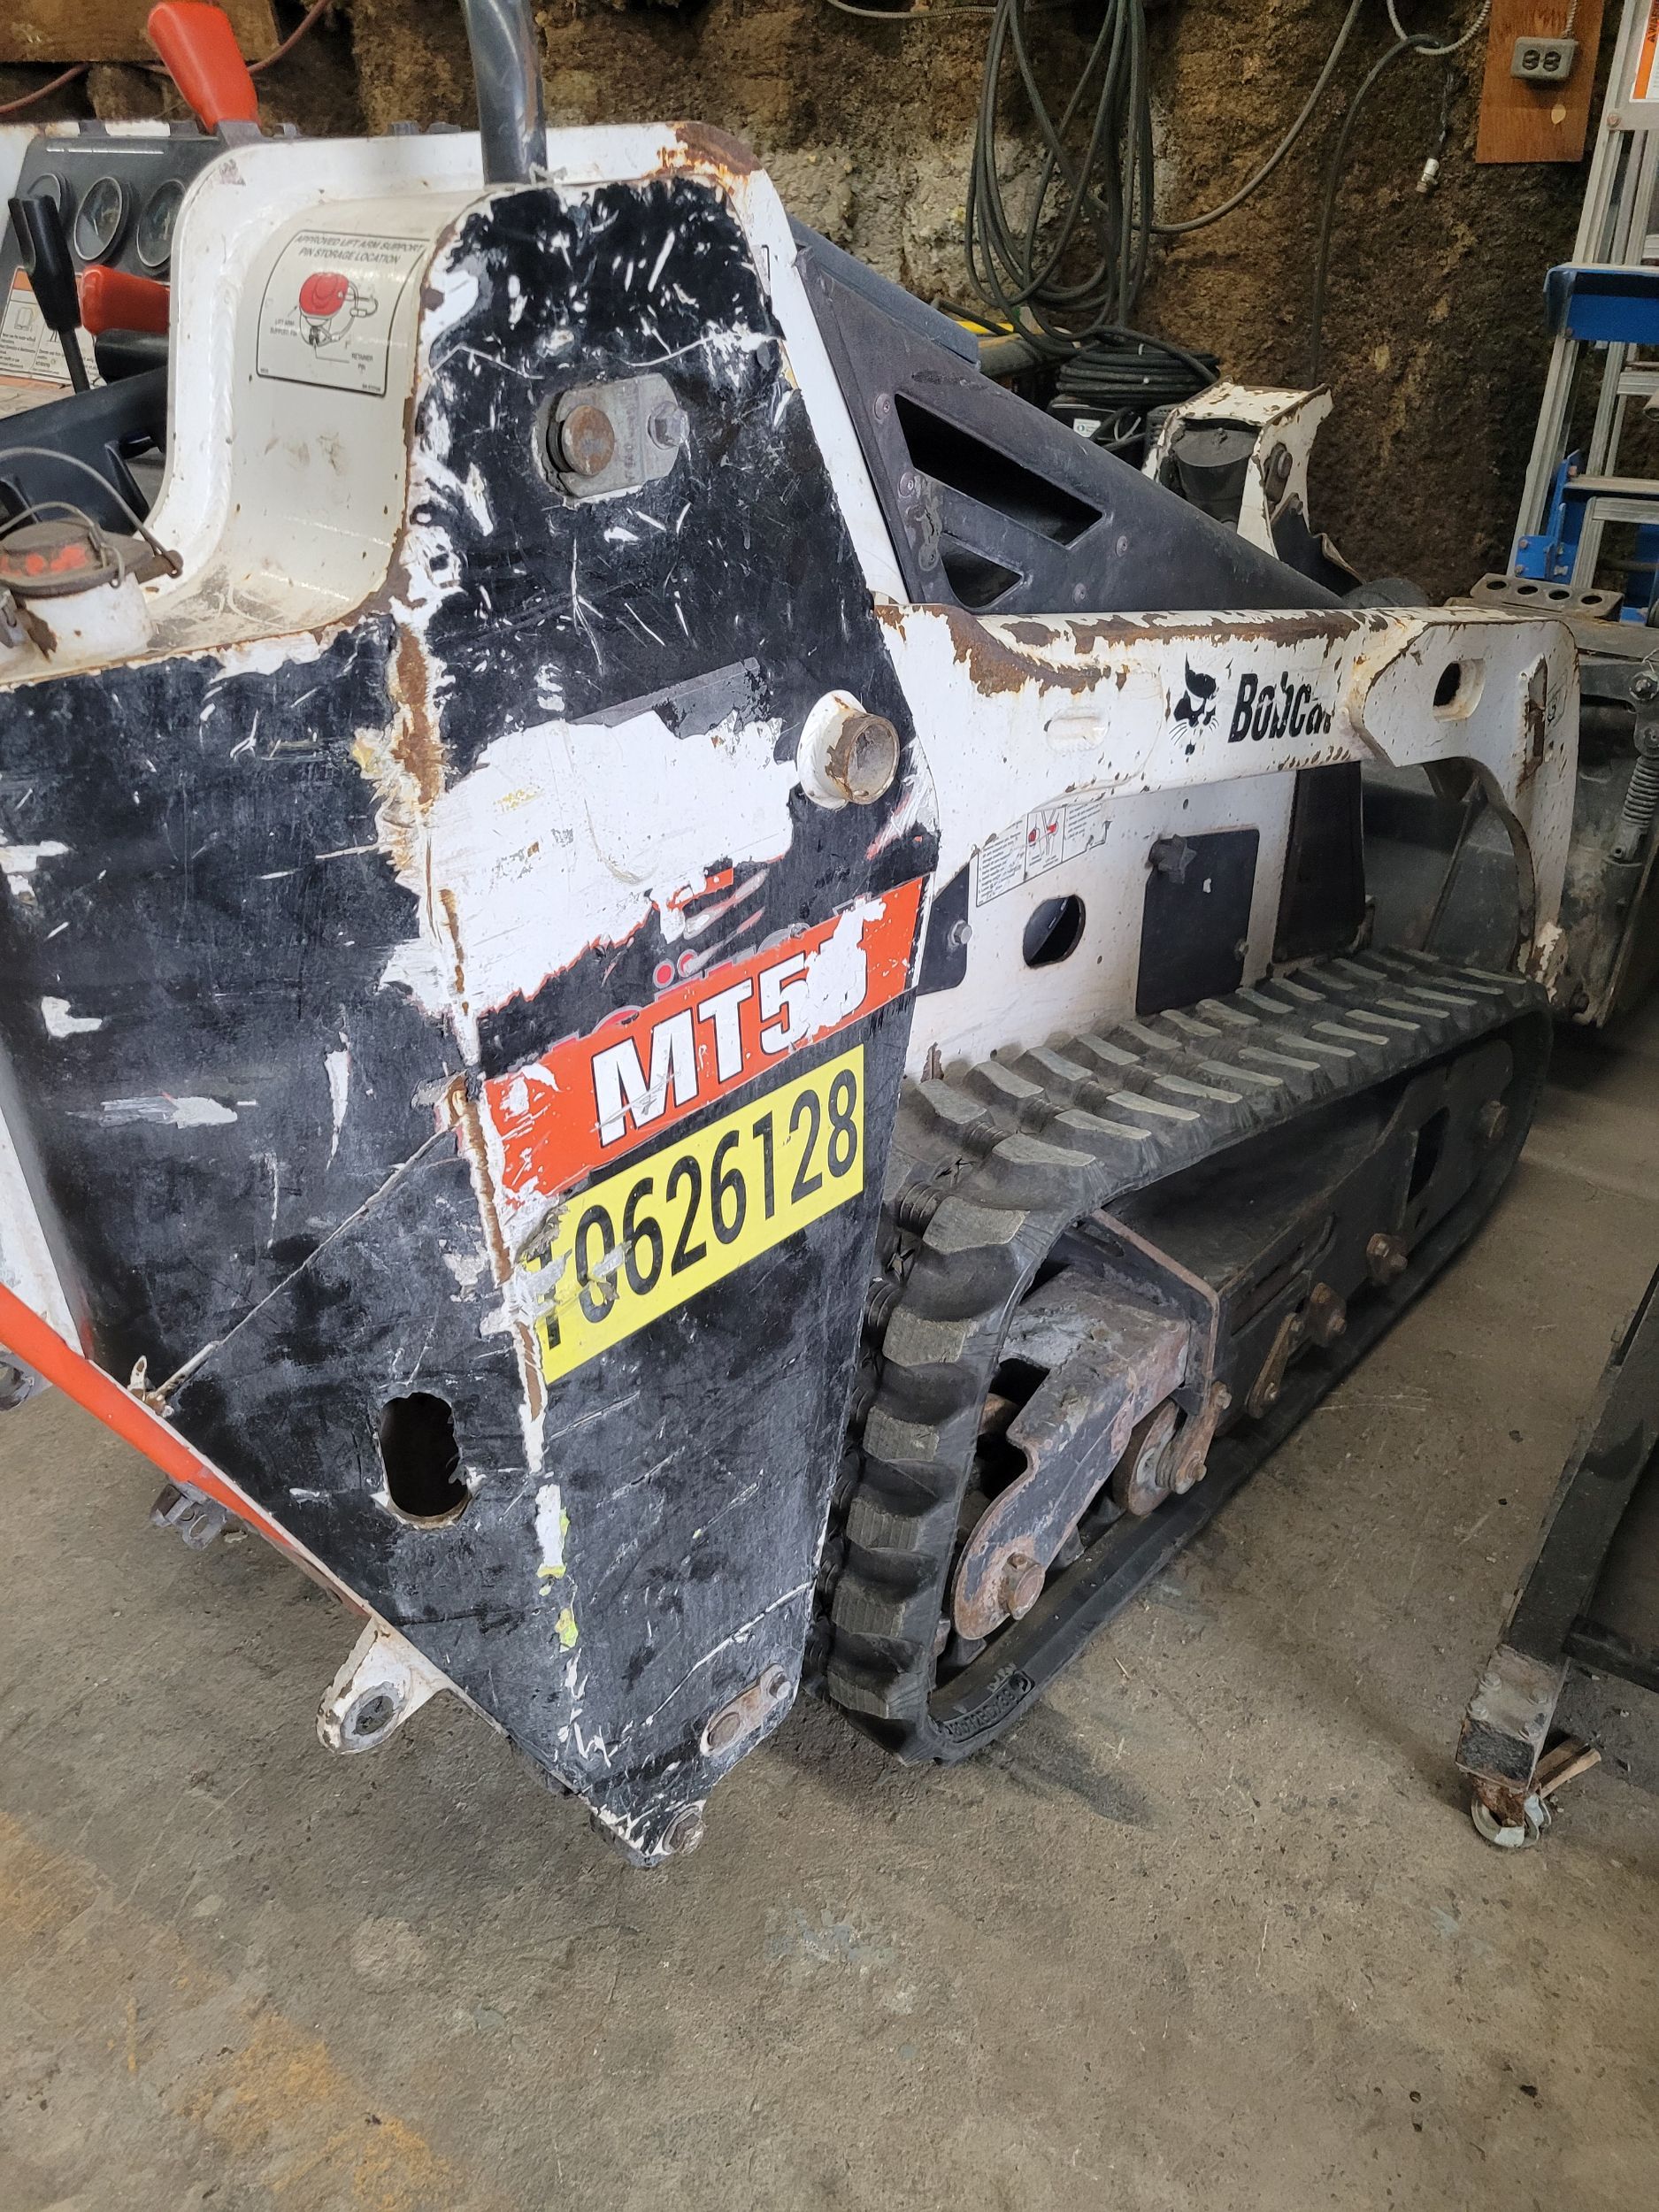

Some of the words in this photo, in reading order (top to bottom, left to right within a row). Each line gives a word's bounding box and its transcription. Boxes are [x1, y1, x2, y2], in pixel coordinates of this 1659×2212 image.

[296, 235, 340, 247] APPROVED
[340, 238, 361, 249] LIFT
[360, 241, 381, 250] ARM
[380, 242, 425, 253] SUPPORT
[298, 247, 313, 257] PIN
[314, 249, 353, 261] STORAGE
[355, 252, 401, 264] LOCATION
